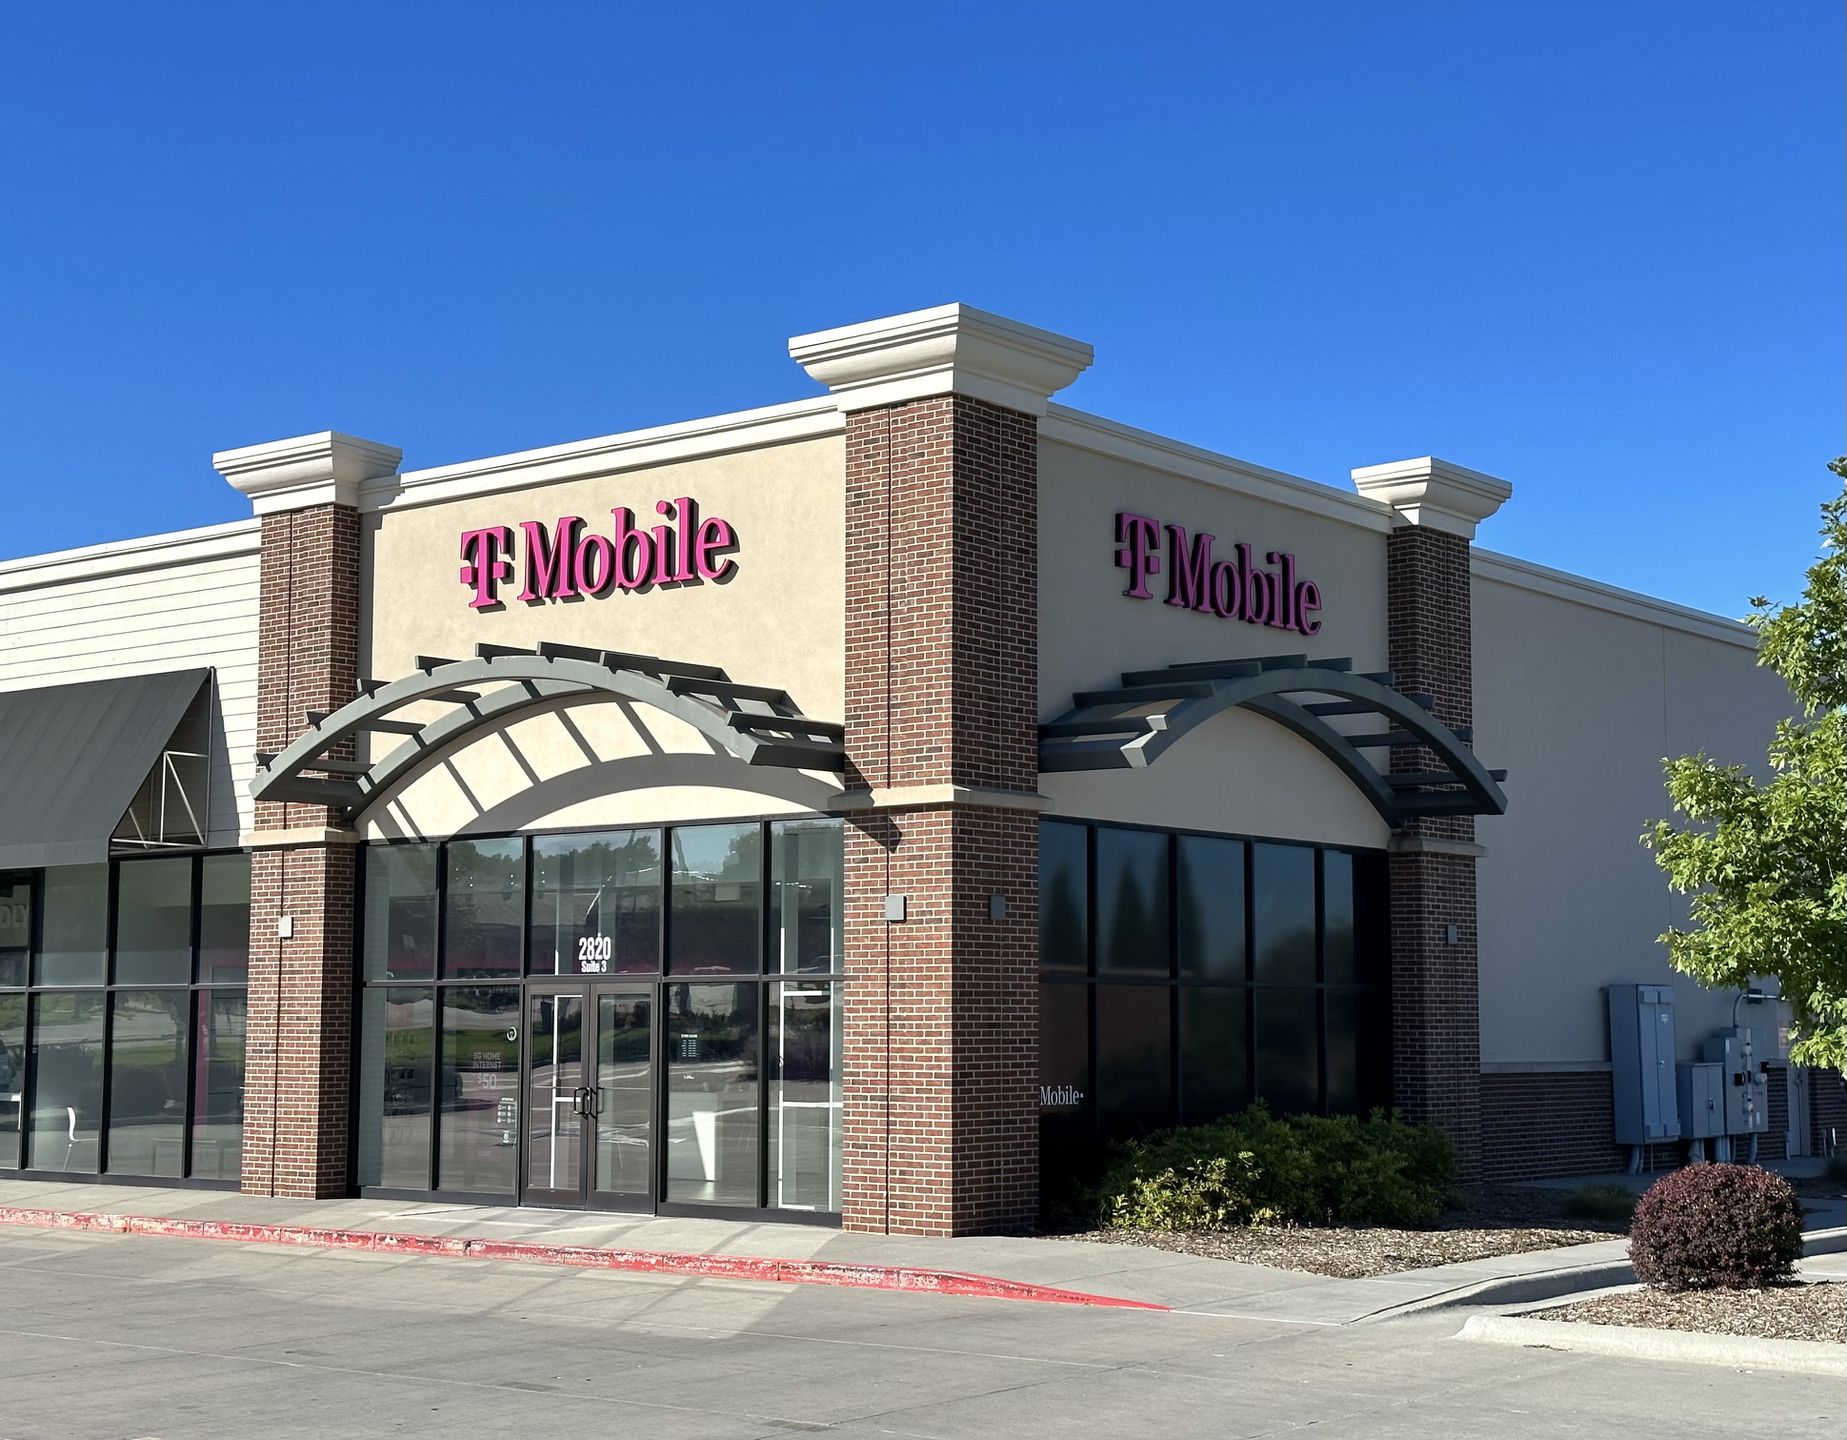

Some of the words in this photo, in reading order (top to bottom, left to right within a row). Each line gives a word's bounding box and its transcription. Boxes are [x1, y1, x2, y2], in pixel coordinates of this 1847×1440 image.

[517, 497, 738, 606] Mobile
[1164, 524, 1322, 636] Mobile
[578, 936, 612, 961] 2820
[580, 960, 600, 973] Suite
[600, 960, 607, 973] 3
[482, 1051, 502, 1061] HOME
